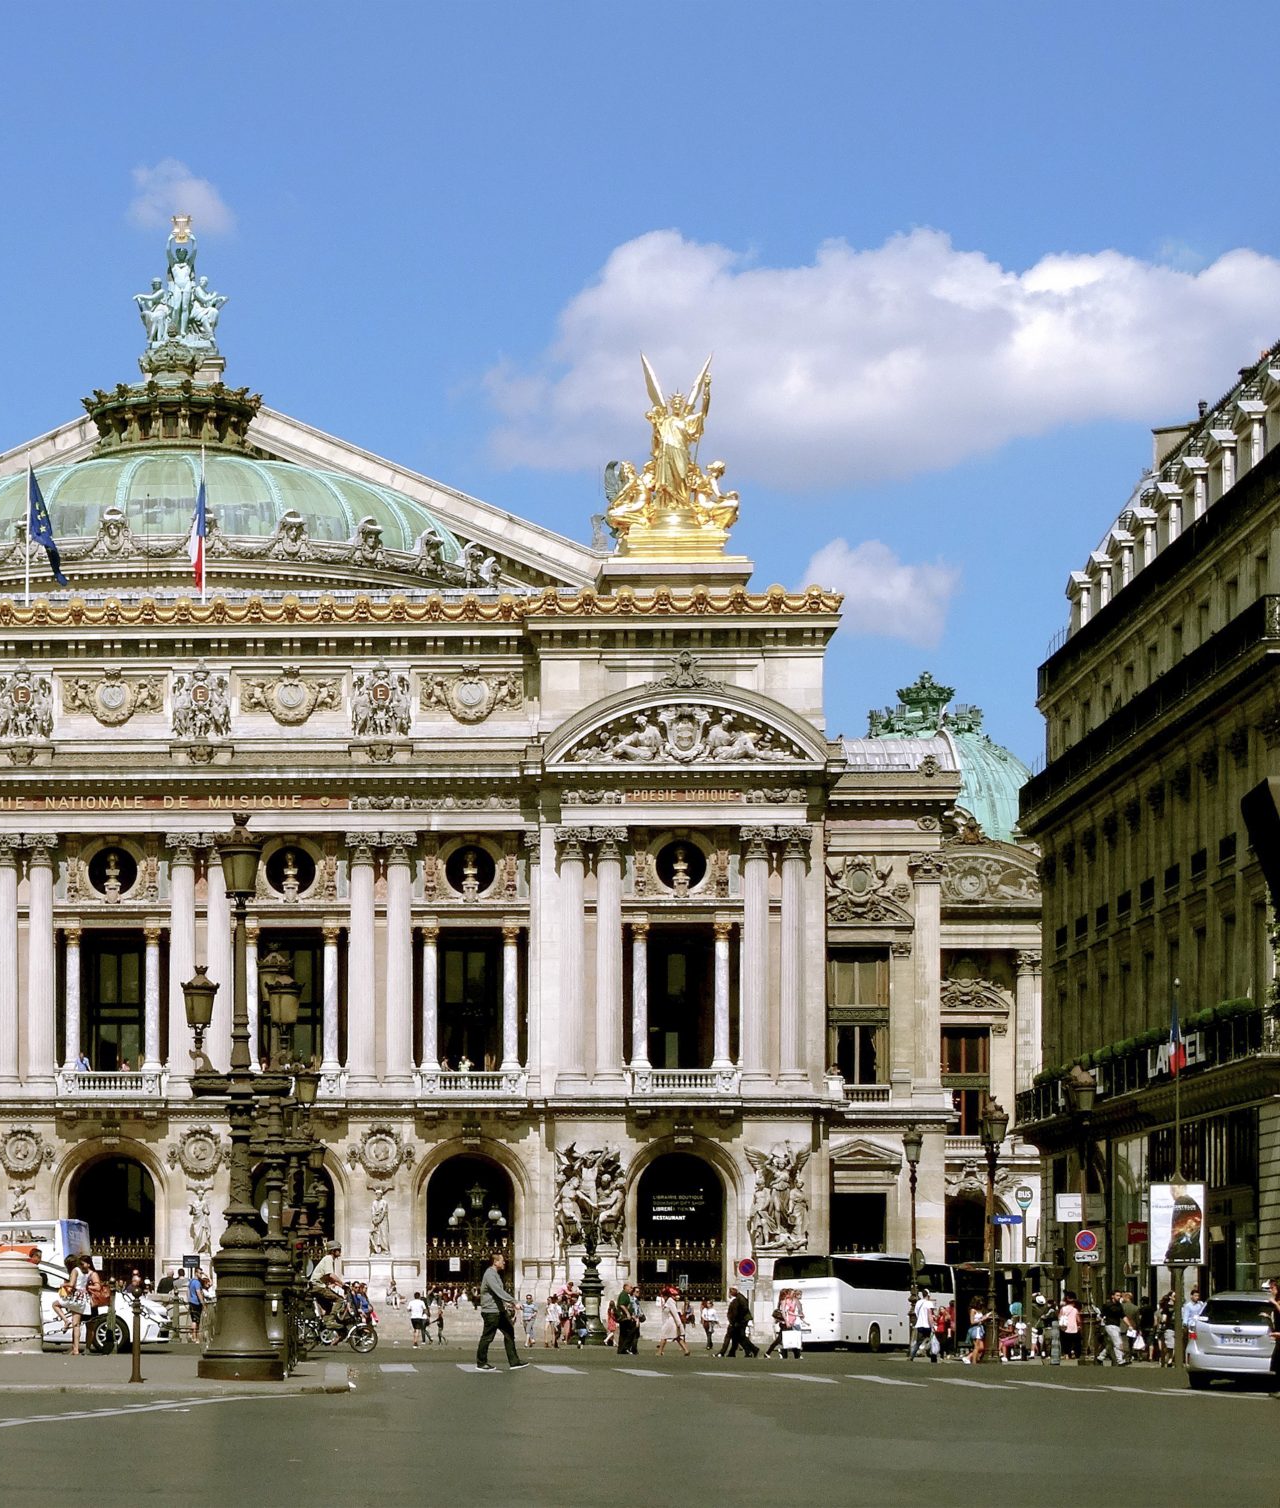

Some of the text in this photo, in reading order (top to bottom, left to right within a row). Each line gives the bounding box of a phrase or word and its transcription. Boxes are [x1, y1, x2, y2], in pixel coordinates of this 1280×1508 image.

[633, 789, 734, 801] POESIE LYRIQUE
[45, 796, 144, 809] NATIONALE
[163, 795, 189, 809] DE
[208, 795, 302, 809] MUSIQUE
